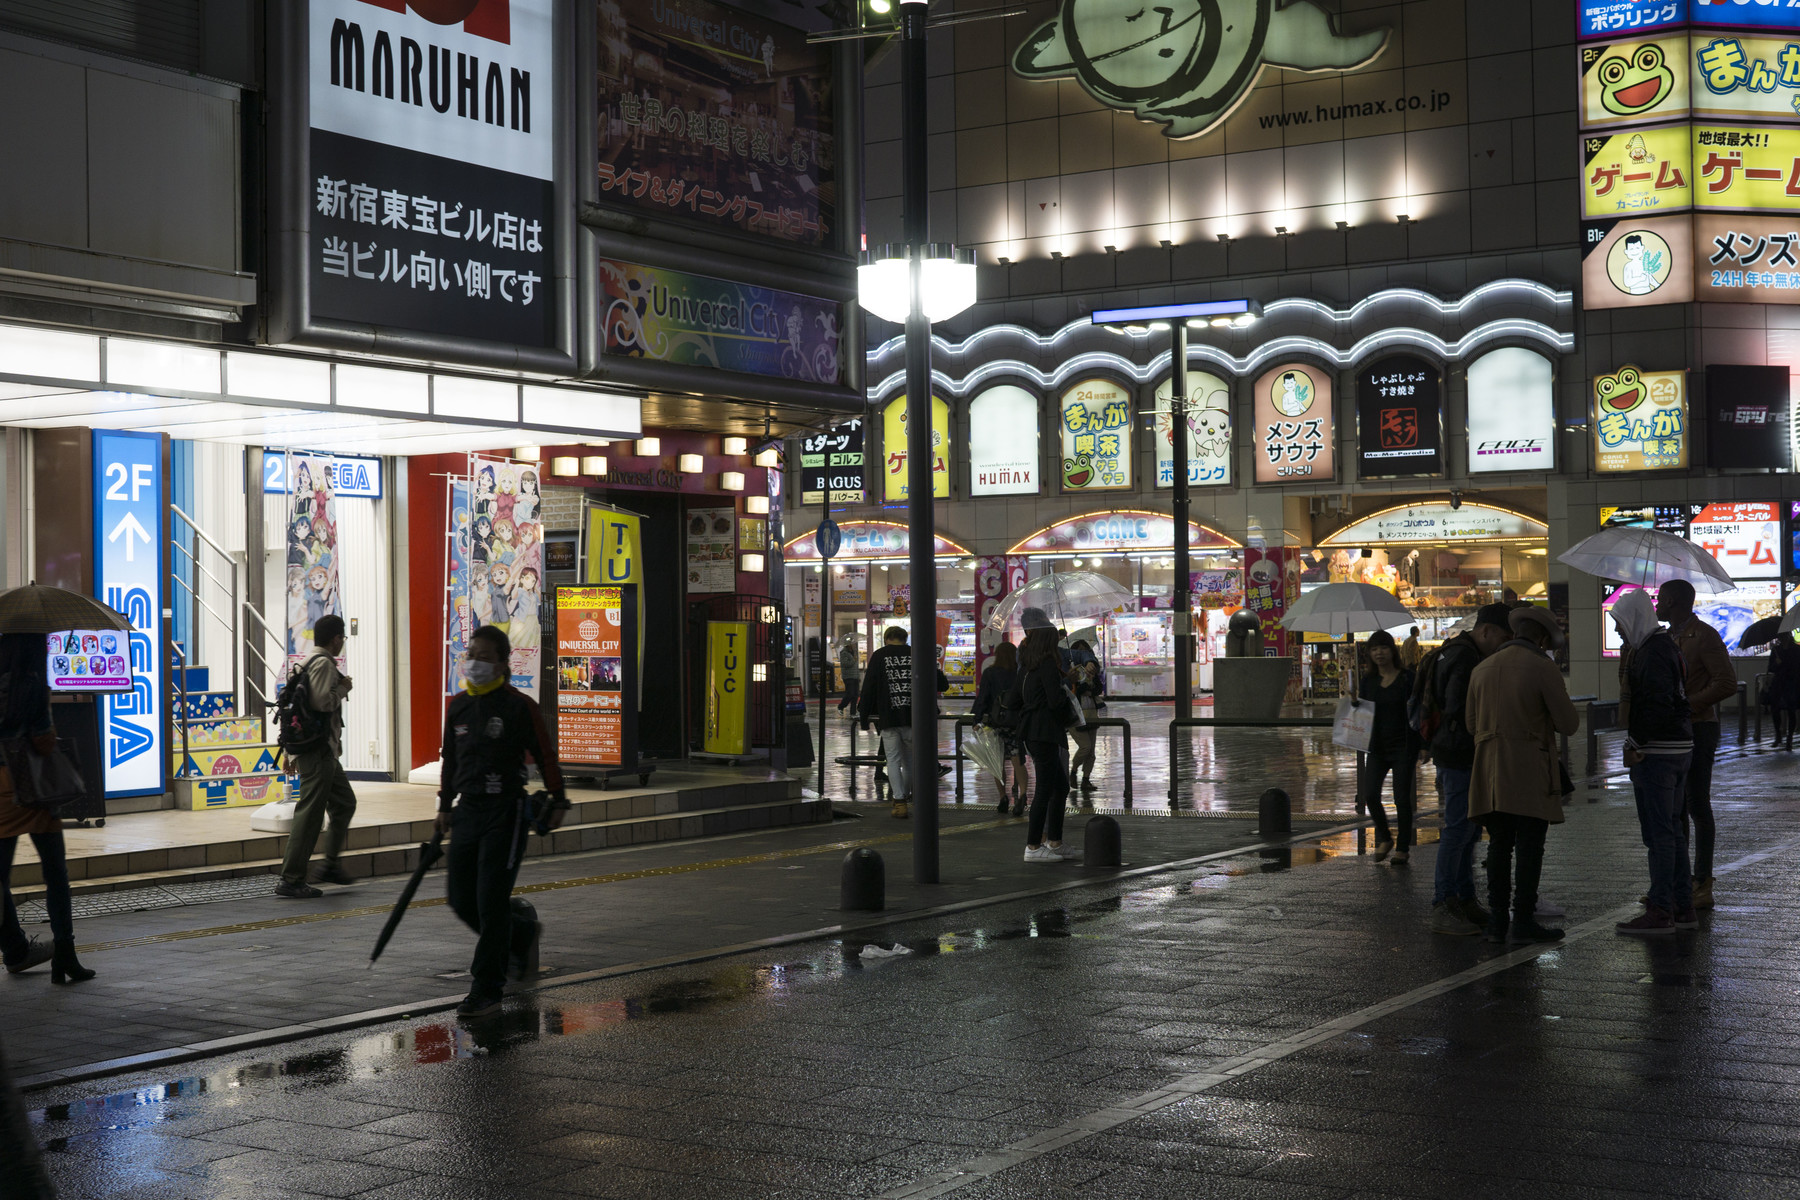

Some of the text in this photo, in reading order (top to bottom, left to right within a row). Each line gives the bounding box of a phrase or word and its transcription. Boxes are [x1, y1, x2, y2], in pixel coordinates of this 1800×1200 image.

[1591, 3, 1677, 30] ボウリング
[729, 24, 759, 59] City
[1583, 49, 1599, 63] 2F
[331, 18, 531, 134] MARUHAN
[1259, 90, 1450, 129] www.humax.co.jp
[619, 92, 809, 171] 世界の料理を楽しむ
[1590, 160, 1687, 197] ゲーム
[317, 175, 543, 252] 新宿東宝ビル店は
[1616, 196, 1659, 210] カーニバル
[1588, 229, 1604, 242] B1F
[323, 236, 541, 305] 当ビル向い側です
[652, 284, 788, 343] Universal City
[1371, 372, 1425, 385] しゃぶしゃぶ
[1652, 382, 1676, 396] 24
[1379, 385, 1415, 397] すき焼き
[1065, 401, 1127, 431] まんが
[1599, 409, 1682, 445] まんが
[1265, 419, 1324, 442] メンズ
[1075, 434, 1119, 456] 喫茶
[1266, 443, 1324, 463] サウナ
[1643, 439, 1679, 456] 喫茶
[833, 454, 861, 465] ゴルフ
[888, 450, 947, 475] ゲム
[106, 463, 153, 501] 2F
[979, 468, 1030, 485] HUMAX
[1161, 466, 1226, 482] ボリング
[1095, 518, 1148, 540] GAME
[1702, 539, 1777, 565] ゲーム
[1194, 580, 1232, 590] カーニバル
[559, 641, 619, 650] UNIVERSAL CITY
